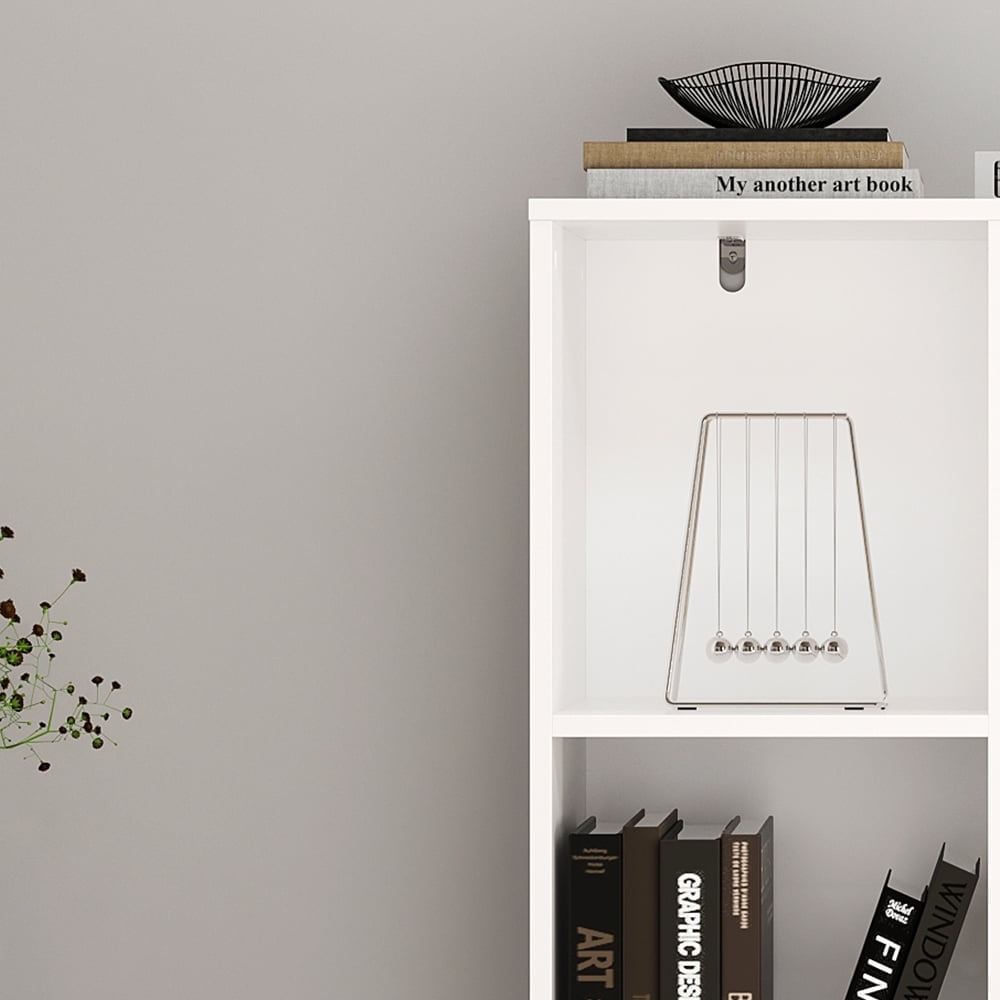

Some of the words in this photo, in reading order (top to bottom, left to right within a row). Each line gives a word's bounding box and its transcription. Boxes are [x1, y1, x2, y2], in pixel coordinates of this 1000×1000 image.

[716, 176, 747, 196] My
[753, 176, 827, 193] another
[833, 178, 861, 193] art
[861, 176, 913, 193] book
[677, 873, 702, 956] GRAPHIC
[576, 926, 614, 988] ART
